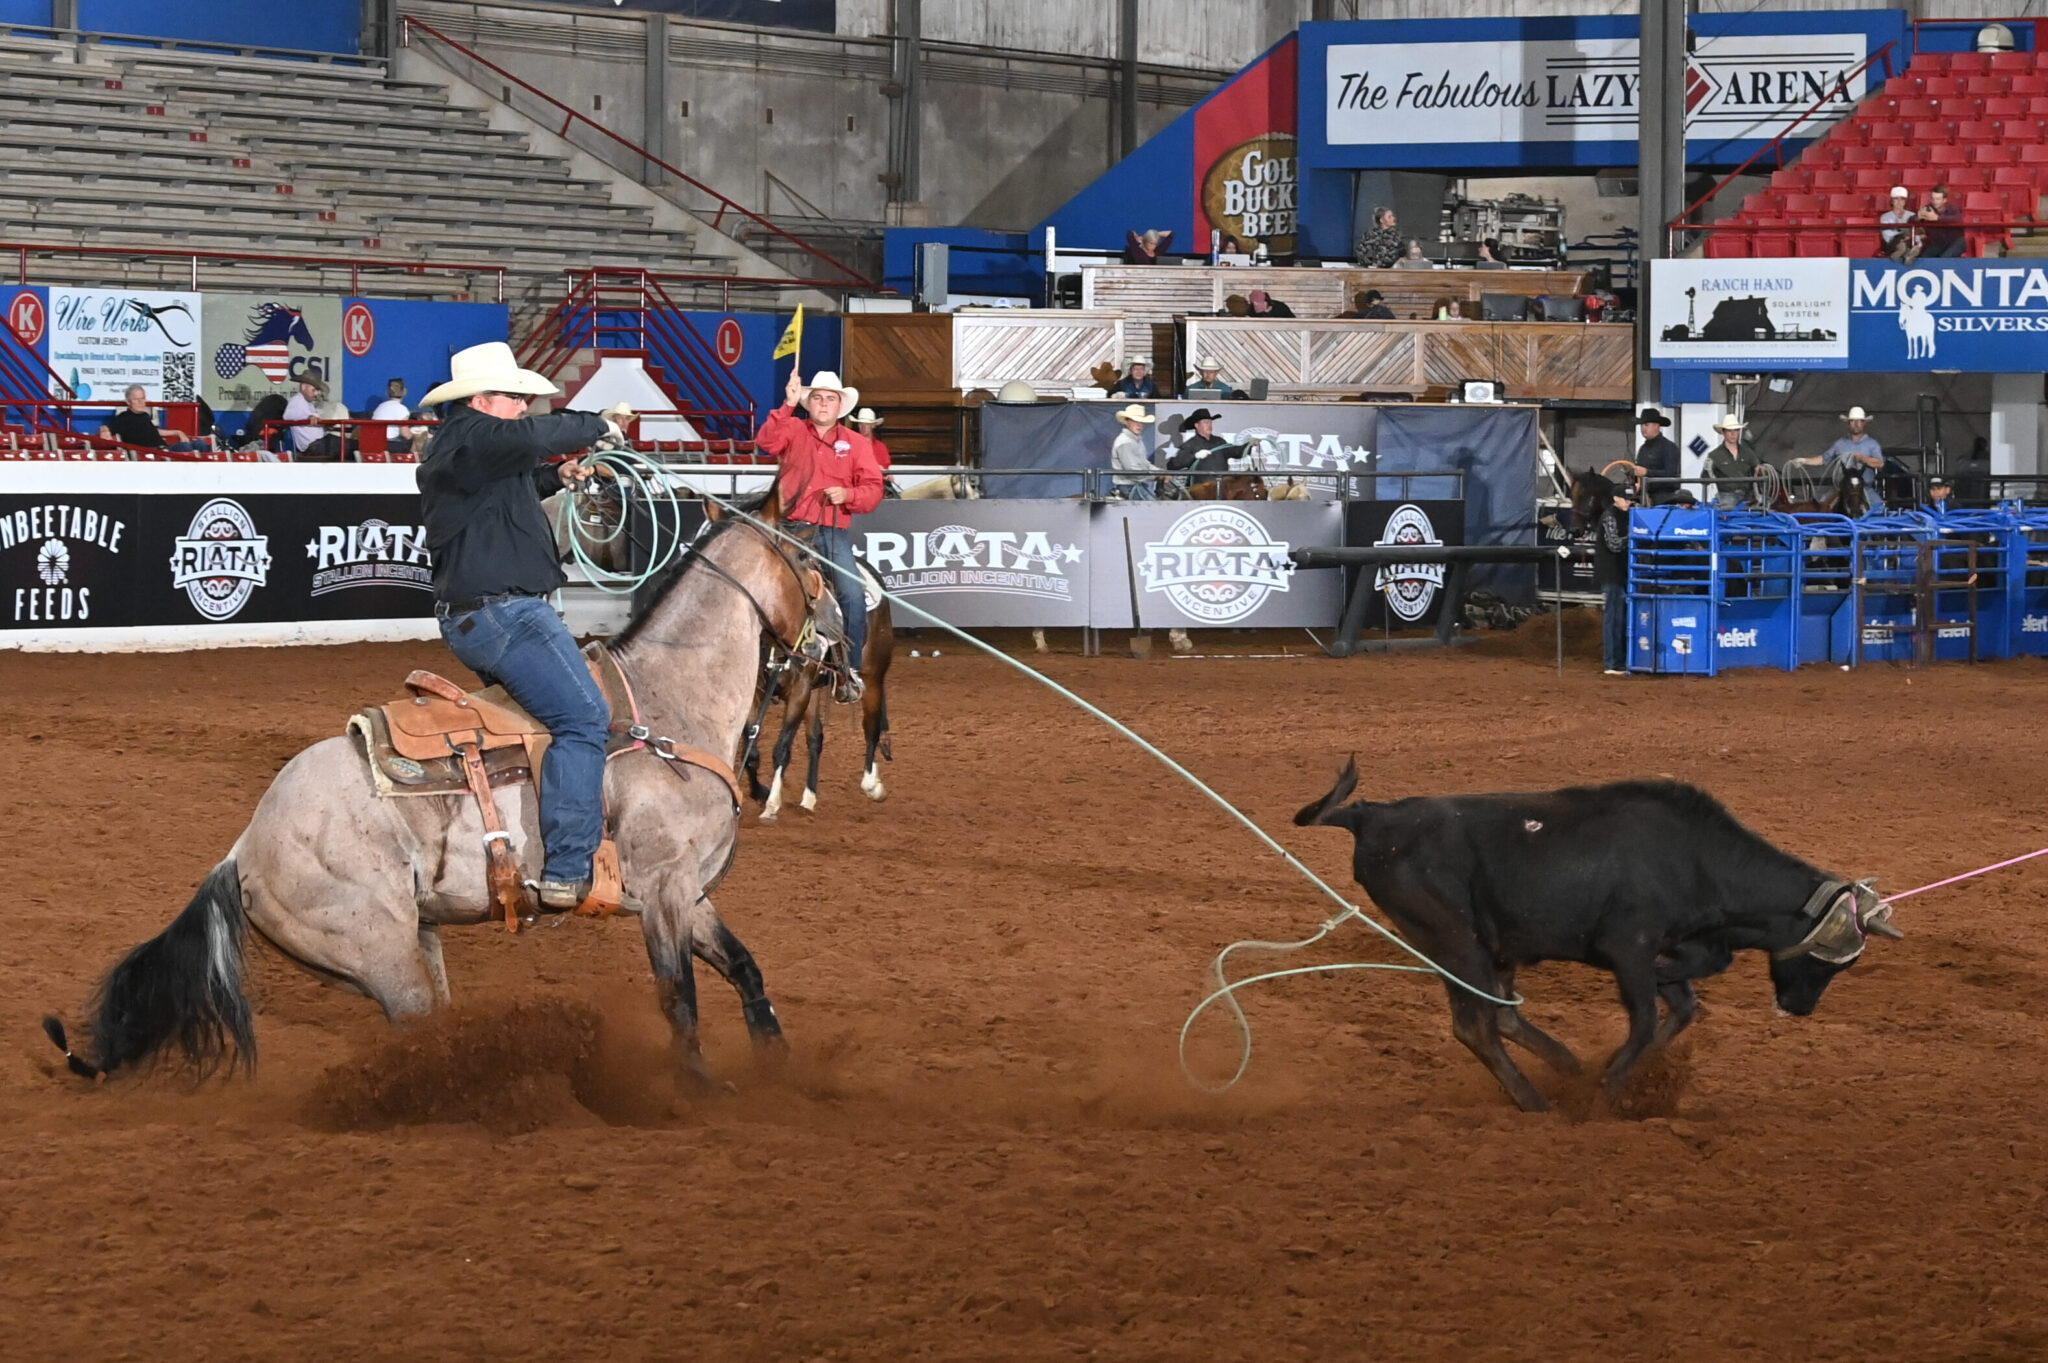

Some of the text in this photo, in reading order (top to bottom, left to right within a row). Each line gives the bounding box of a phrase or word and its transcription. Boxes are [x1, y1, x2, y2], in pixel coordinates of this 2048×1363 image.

[1337, 71, 1389, 110] The
[1395, 69, 1540, 109] Fabulous
[1722, 70, 1854, 105] ARENA
[1241, 150, 1297, 187] GOL
[1223, 180, 1298, 216] BUCK
[1701, 278, 1793, 291] RANCH HAND
[1852, 268, 2048, 308] MONTA
[18, 304, 37, 331] K
[55, 295, 151, 332] Wire Works
[1804, 300, 1832, 308] LIGHT
[351, 315, 367, 340] K
[1937, 316, 2048, 332] SILVERS
[78, 336, 128, 346] CUSTOM JEWELRY
[724, 330, 735, 354] L
[289, 356, 330, 382] CSI
[0, 505, 125, 553] NBEETABLE
[197, 507, 246, 530] STALLION
[1180, 513, 1256, 537] STALLION
[318, 523, 434, 570] RIATA
[864, 529, 1064, 575] RIATA
[181, 545, 260, 577] RIATA
[1155, 549, 1281, 581] RIATA
[312, 563, 433, 589] STALLION INCENTIV
[881, 570, 1069, 593] ALLION INCENTIVE
[15, 587, 90, 621] FEEDS
[194, 586, 246, 611] INCENTIVE
[1177, 589, 1258, 617] INCENTIVE
